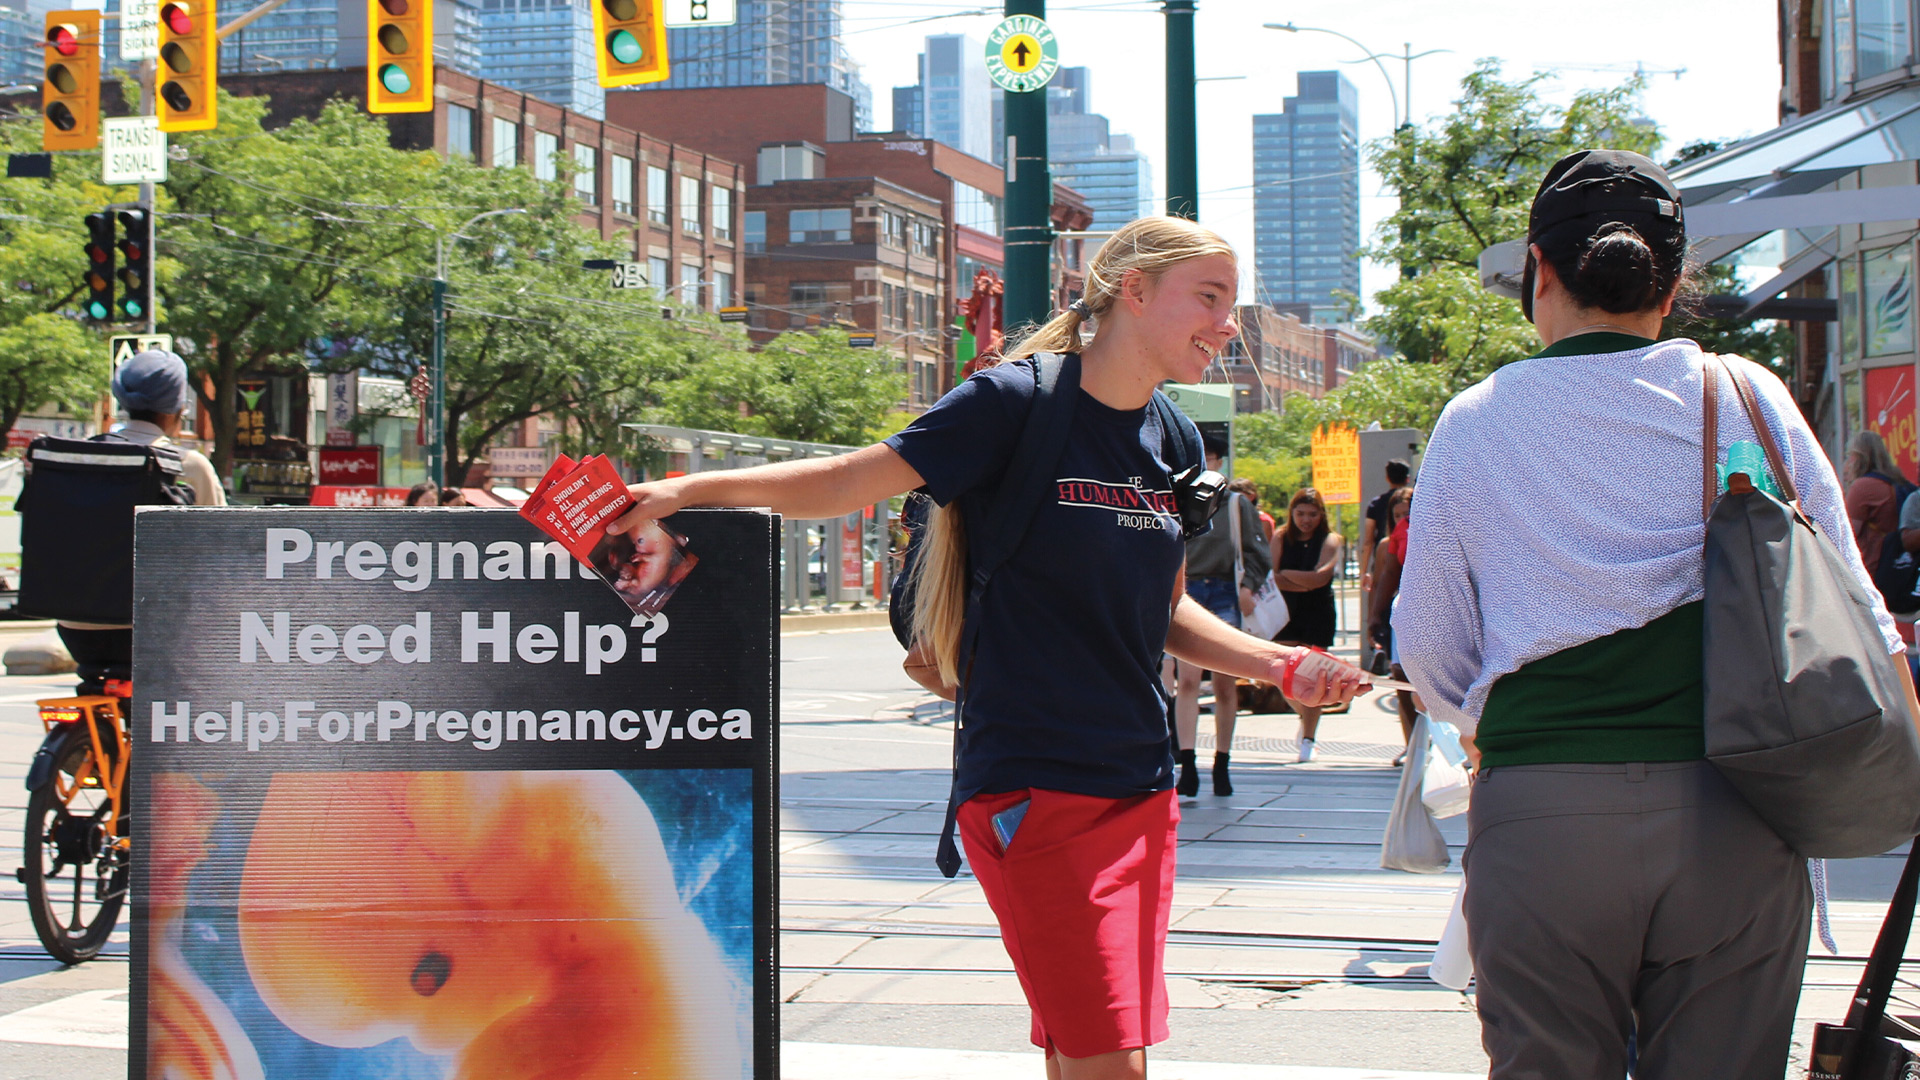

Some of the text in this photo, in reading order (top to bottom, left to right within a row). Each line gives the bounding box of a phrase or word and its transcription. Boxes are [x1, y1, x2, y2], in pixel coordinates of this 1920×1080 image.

[125, 38, 157, 50] SIGNA
[990, 17, 1053, 45] GARDINER
[986, 55, 1057, 89] EXPRESSWAY
[109, 126, 160, 148] TRANSIT
[112, 153, 157, 173] SIGNAL
[552, 474, 590, 505] SHOULDN'T
[563, 481, 614, 521] HUMAN BEINGS
[1058, 483, 1140, 507] HUMAN
[558, 499, 574, 513] ALL
[569, 510, 589, 530] HAVE
[575, 513, 601, 538] HUMAN
[598, 494, 628, 519] RIGHTS?
[239, 611, 670, 675] Need Help?
[150, 700, 753, 752] HelpForPregnancy.ca
